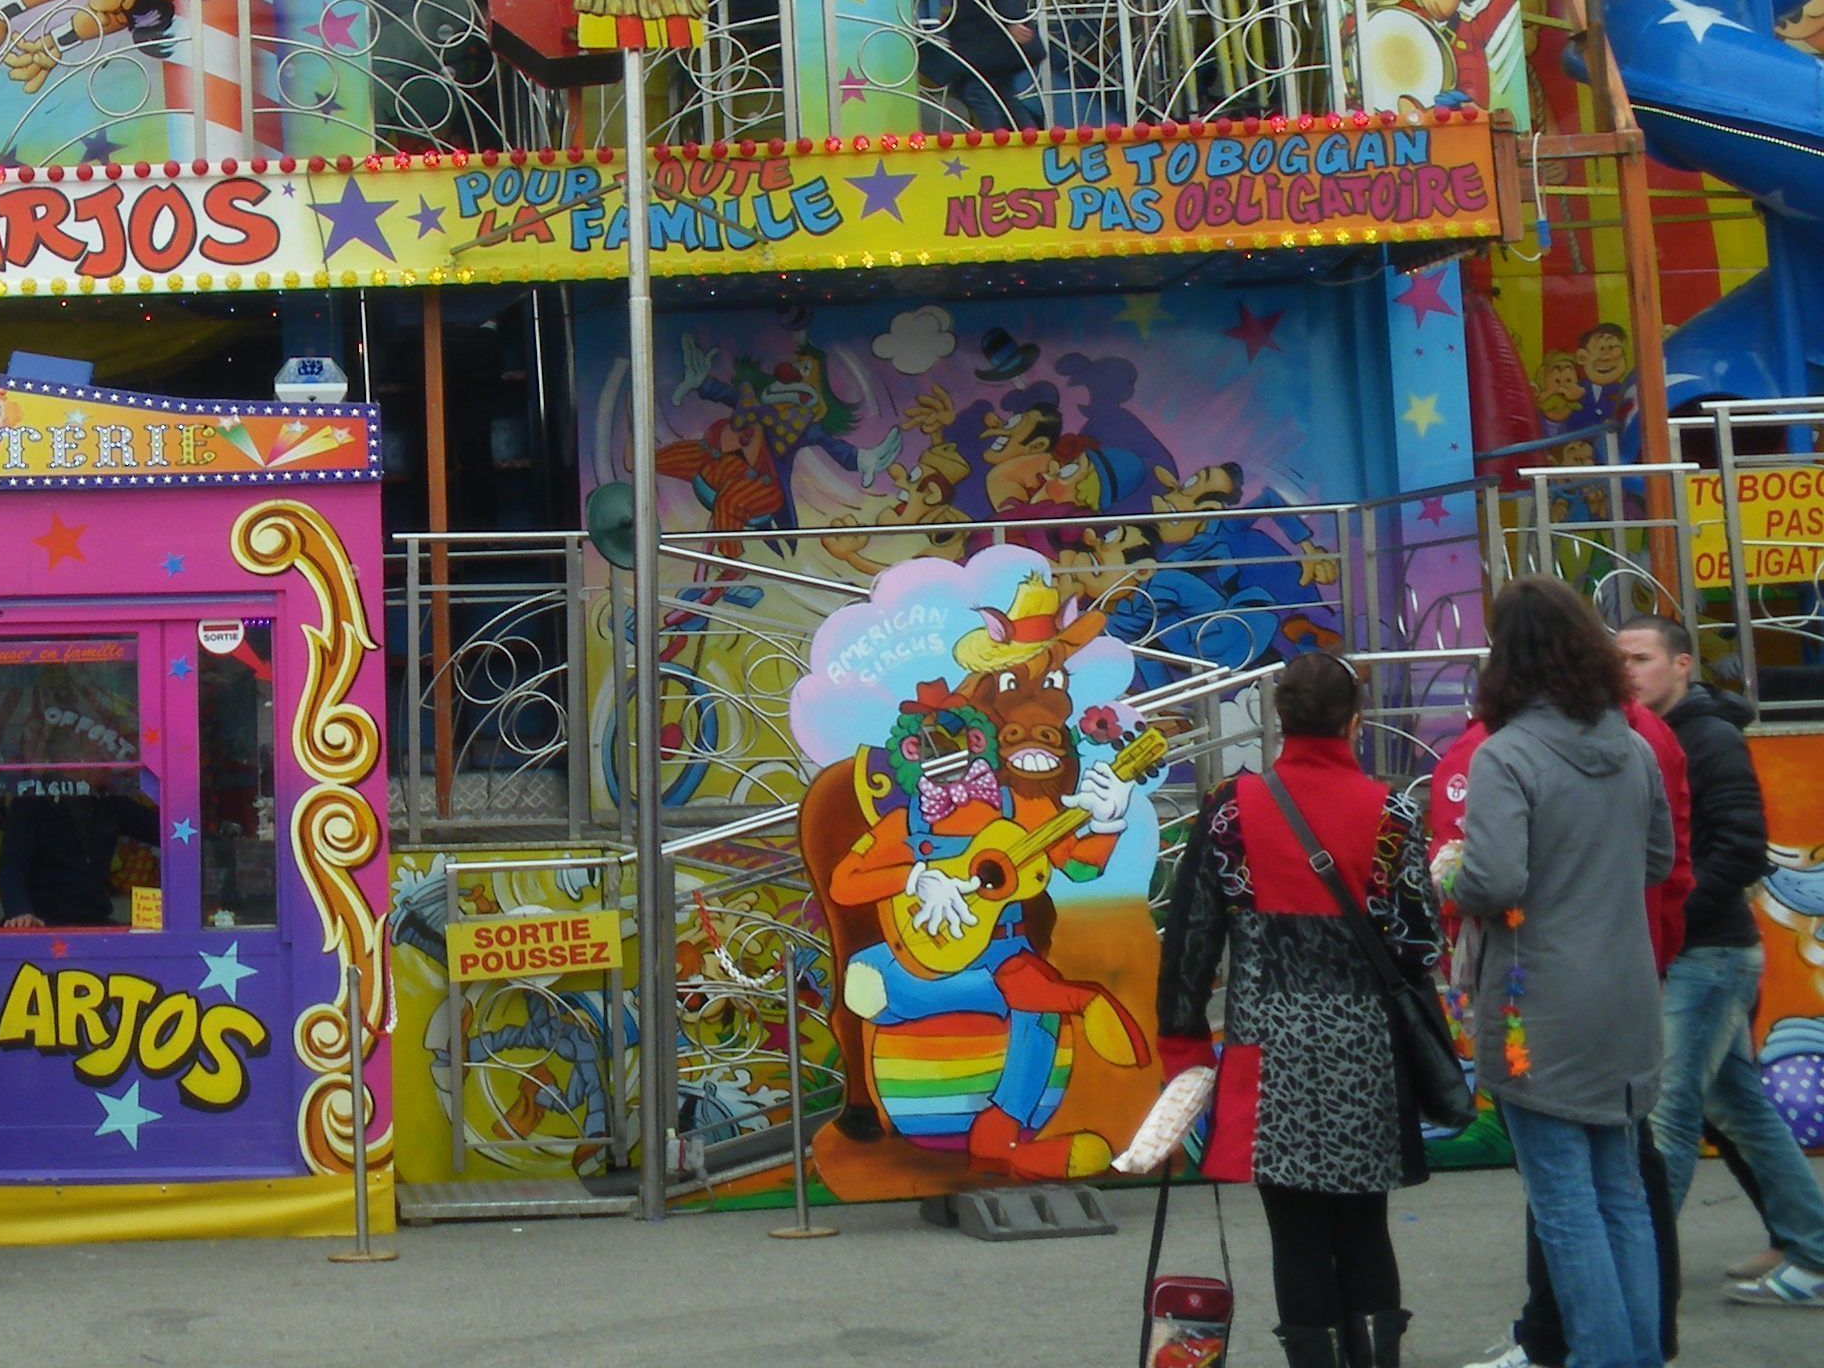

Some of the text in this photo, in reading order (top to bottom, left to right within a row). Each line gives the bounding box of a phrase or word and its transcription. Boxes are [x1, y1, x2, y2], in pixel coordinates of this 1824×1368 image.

[1042, 130, 1432, 185] LE TOBOGGAN
[454, 155, 794, 218] POUR OUTE
[475, 204, 556, 248] LA
[1068, 186, 1165, 234] PAS
[1765, 507, 1824, 538] PAS
[203, 632, 239, 642] SORTIE
[826, 604, 948, 685] AMERICAN
[858, 632, 947, 685] CIRCUS
[474, 918, 592, 950] SORTIE
[459, 941, 611, 976] POUSSEZ
